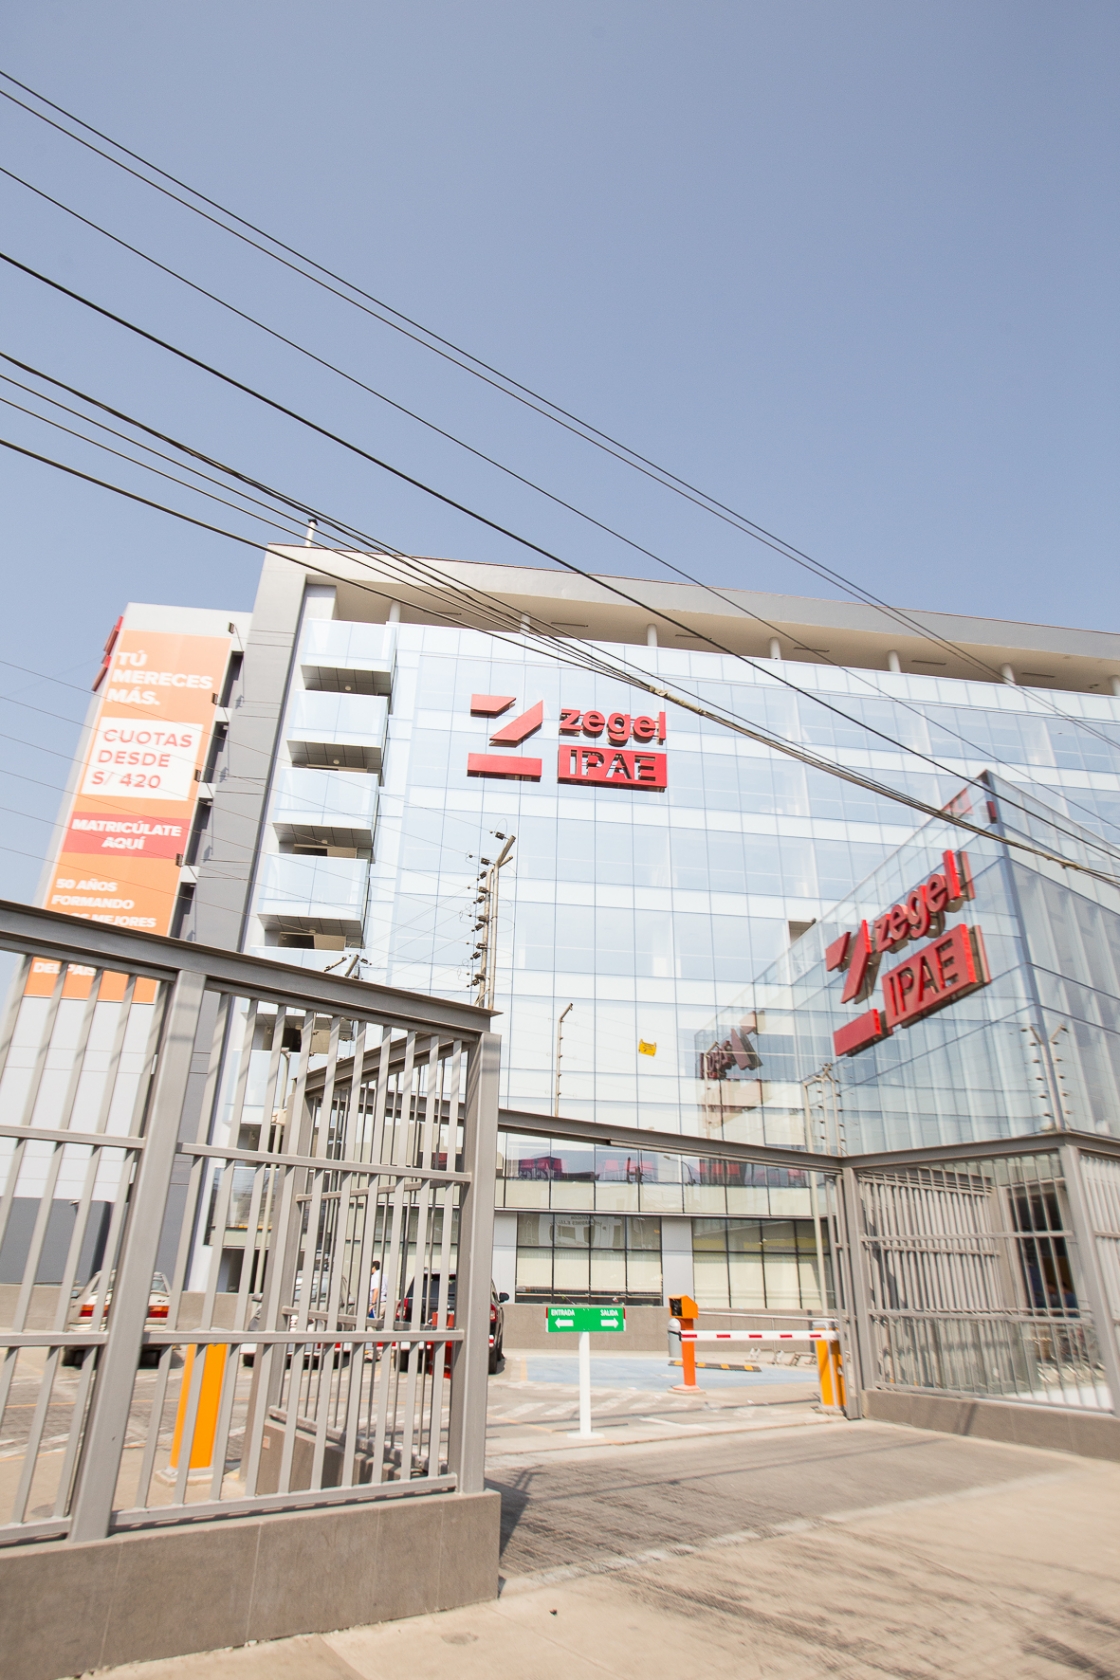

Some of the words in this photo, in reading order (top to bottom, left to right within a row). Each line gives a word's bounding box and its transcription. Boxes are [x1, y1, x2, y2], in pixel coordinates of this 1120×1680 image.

[118, 651, 147, 667] TÚ
[113, 670, 213, 689] MERECES
[107, 687, 160, 705] MÁS.
[559, 709, 667, 743] zegel
[103, 729, 192, 747] CUOTAS
[97, 750, 171, 768] DESDE
[570, 750, 656, 781] IPAE
[120, 773, 162, 789] 420
[72, 819, 182, 837] MATRICÚLATE
[102, 836, 147, 850] AQUÍ
[56, 878, 75, 889] 50
[76, 879, 117, 891] AÑOS
[51, 894, 134, 909] FORMANDO
[874, 850, 961, 953] zegel
[92, 913, 157, 928] MEJORES
[32, 961, 60, 975] DEL
[889, 938, 959, 1016] IPAE
[551, 1308, 575, 1317] ENTRADA
[600, 1309, 619, 1317] SALIDA
